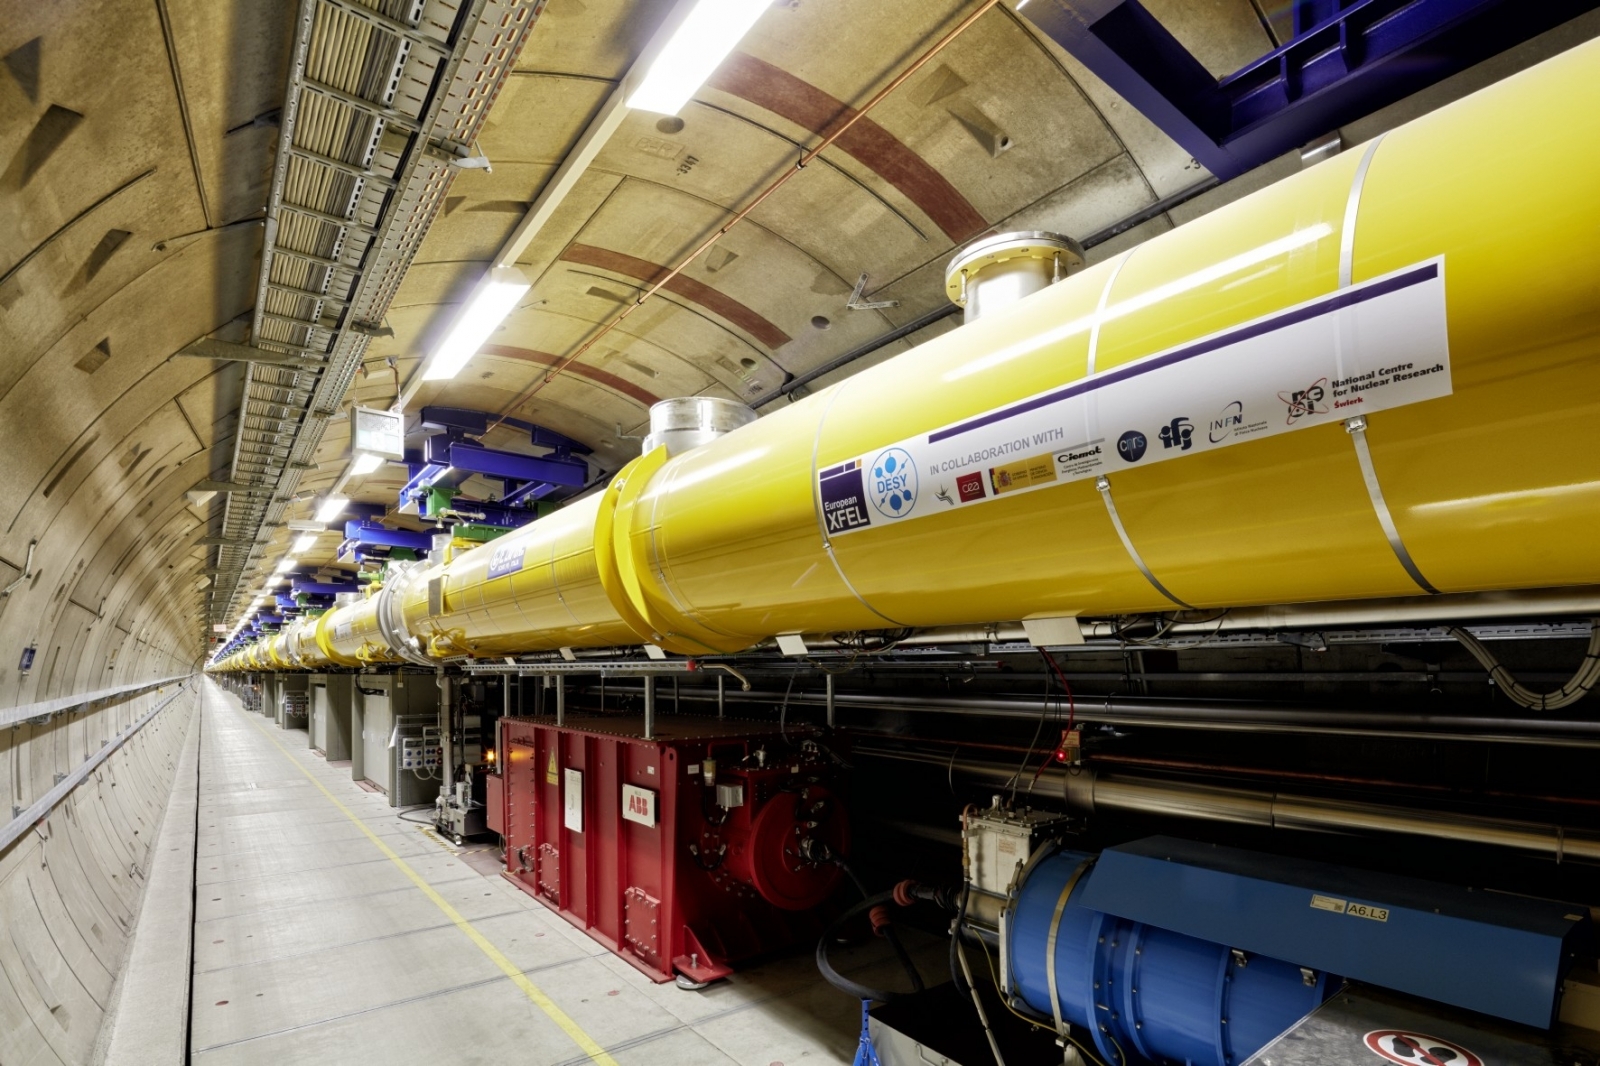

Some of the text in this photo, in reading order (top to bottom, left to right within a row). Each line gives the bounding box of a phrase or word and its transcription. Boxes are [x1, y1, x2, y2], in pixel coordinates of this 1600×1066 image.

[1332, 362, 1414, 389] National Centre
[1333, 363, 1443, 398] for Nuclear Research
[1210, 414, 1242, 431] INFN
[930, 427, 1064, 476] IN COLLABORATION WITH
[877, 473, 907, 494] DESY
[962, 481, 980, 493] cea
[824, 495, 857, 512] European
[827, 506, 868, 531] XFEL
[628, 794, 648, 816] ABB
[1348, 904, 1387, 920] A6.L3
